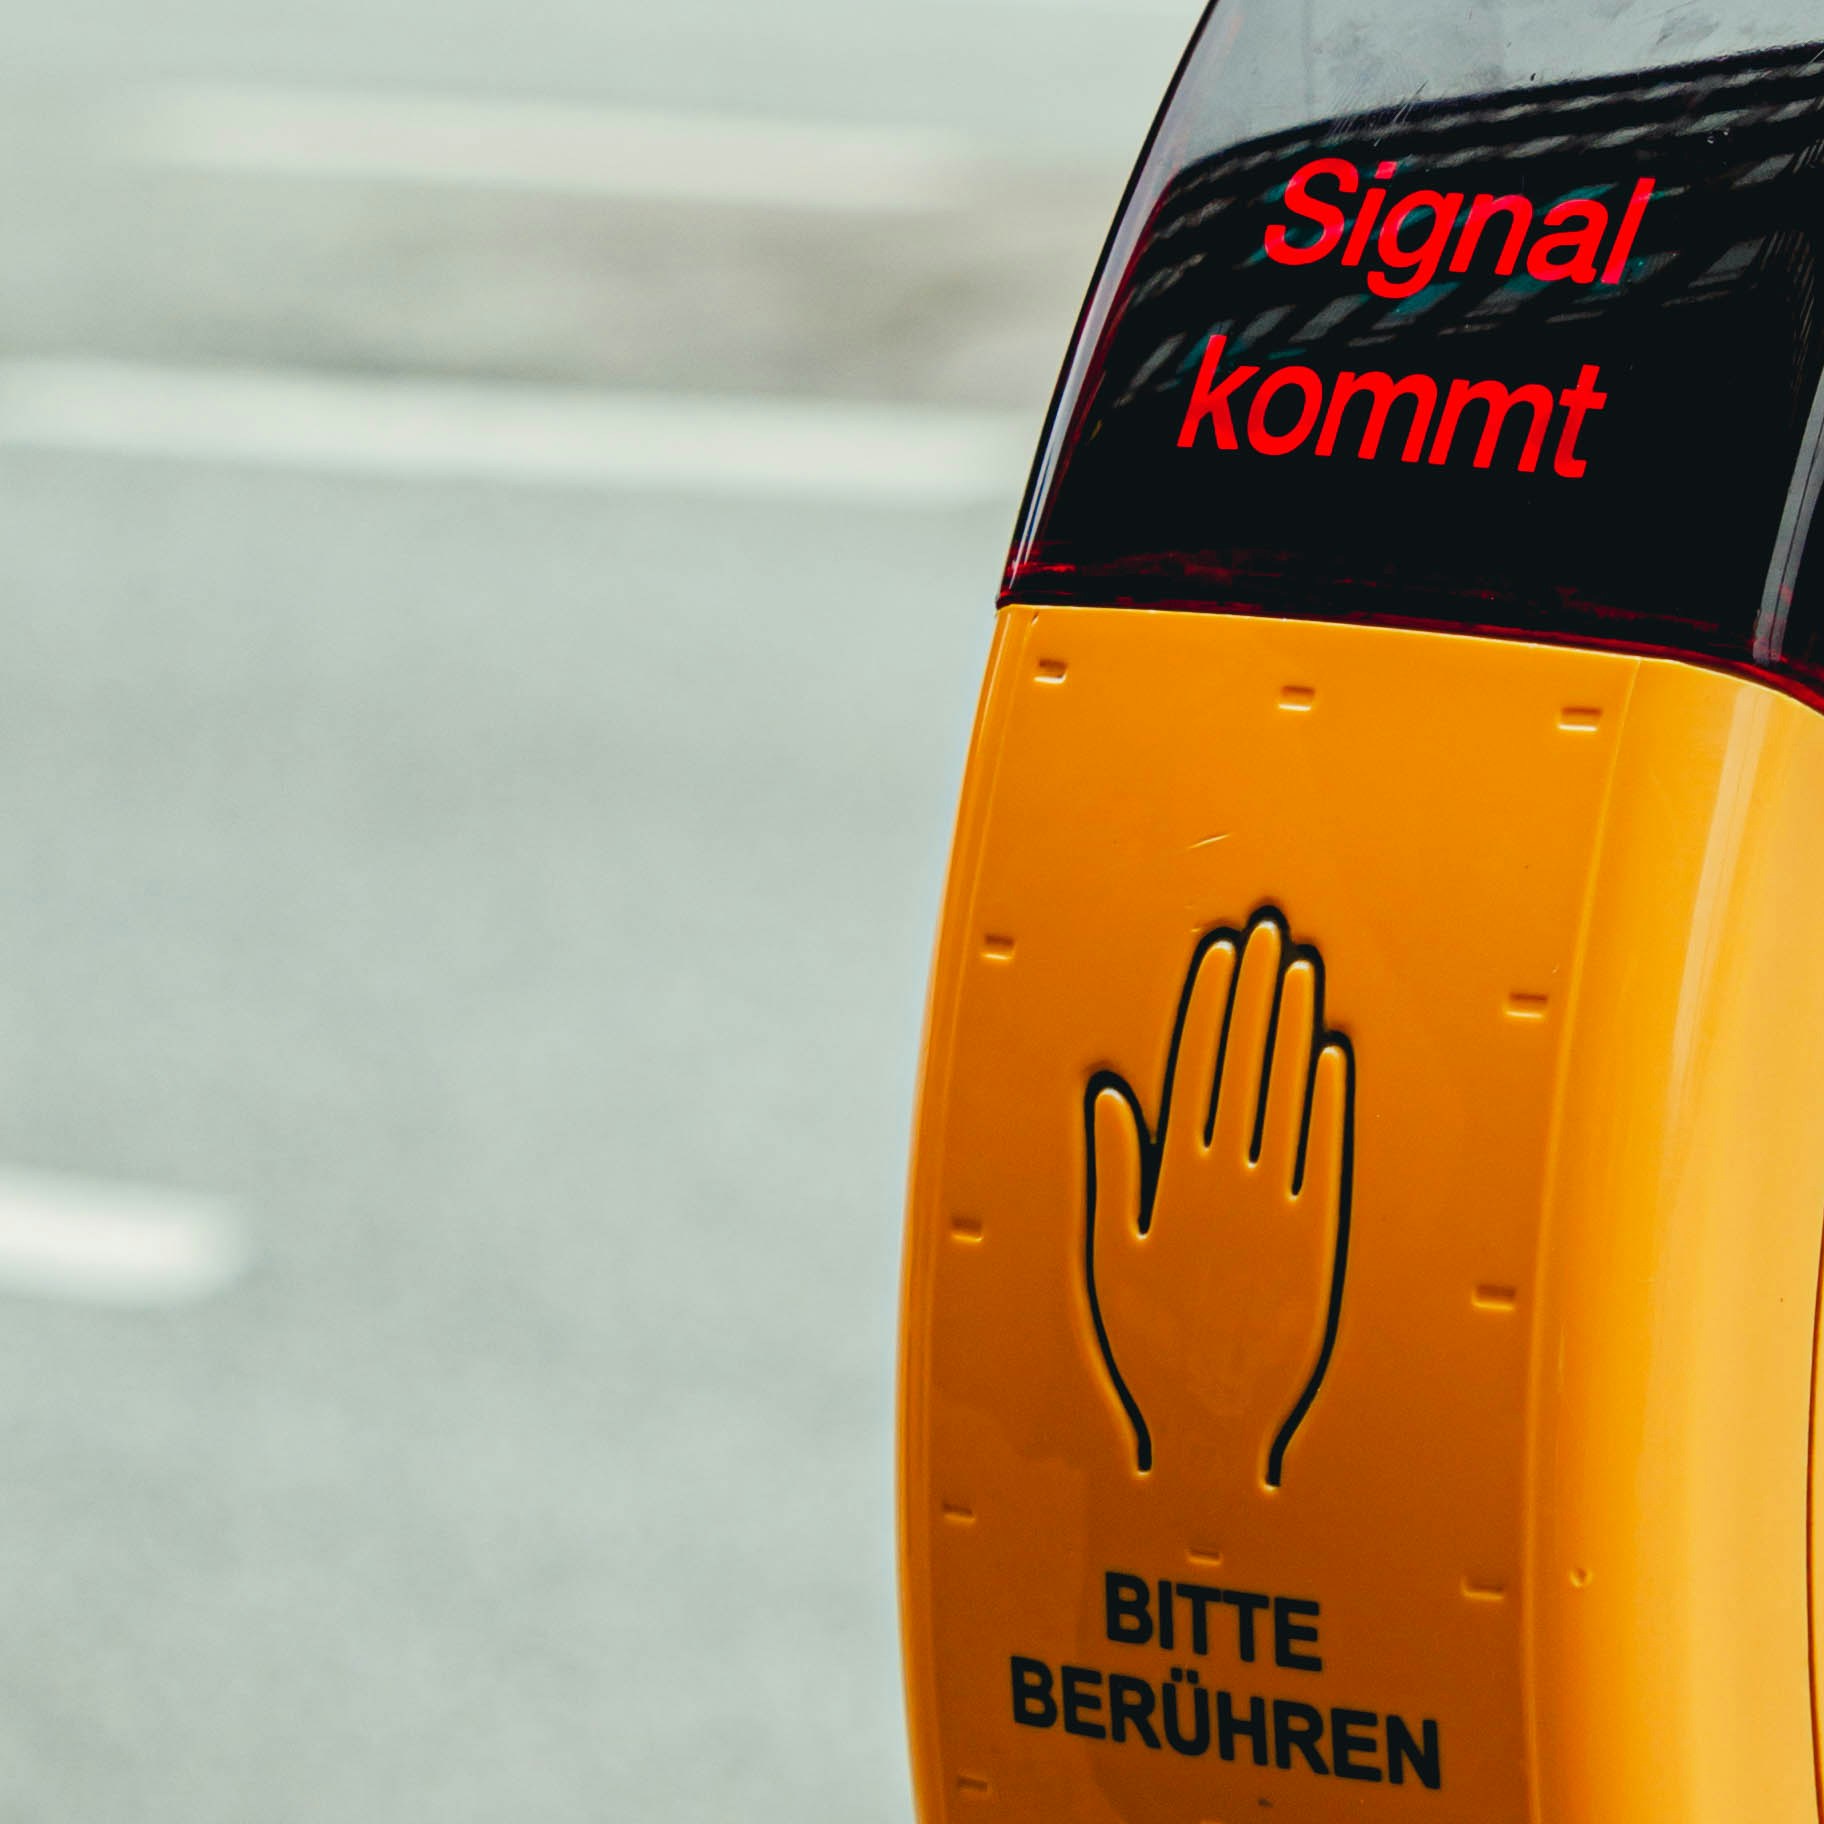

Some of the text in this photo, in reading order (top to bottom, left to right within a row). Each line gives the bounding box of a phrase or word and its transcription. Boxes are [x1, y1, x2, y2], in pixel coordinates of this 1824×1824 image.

[1264, 157, 1656, 299] Signal
[1176, 334, 1608, 479] kommt
[1104, 1571, 1323, 1672] BITTE
[1010, 1655, 1442, 1790] BERÜHREN
